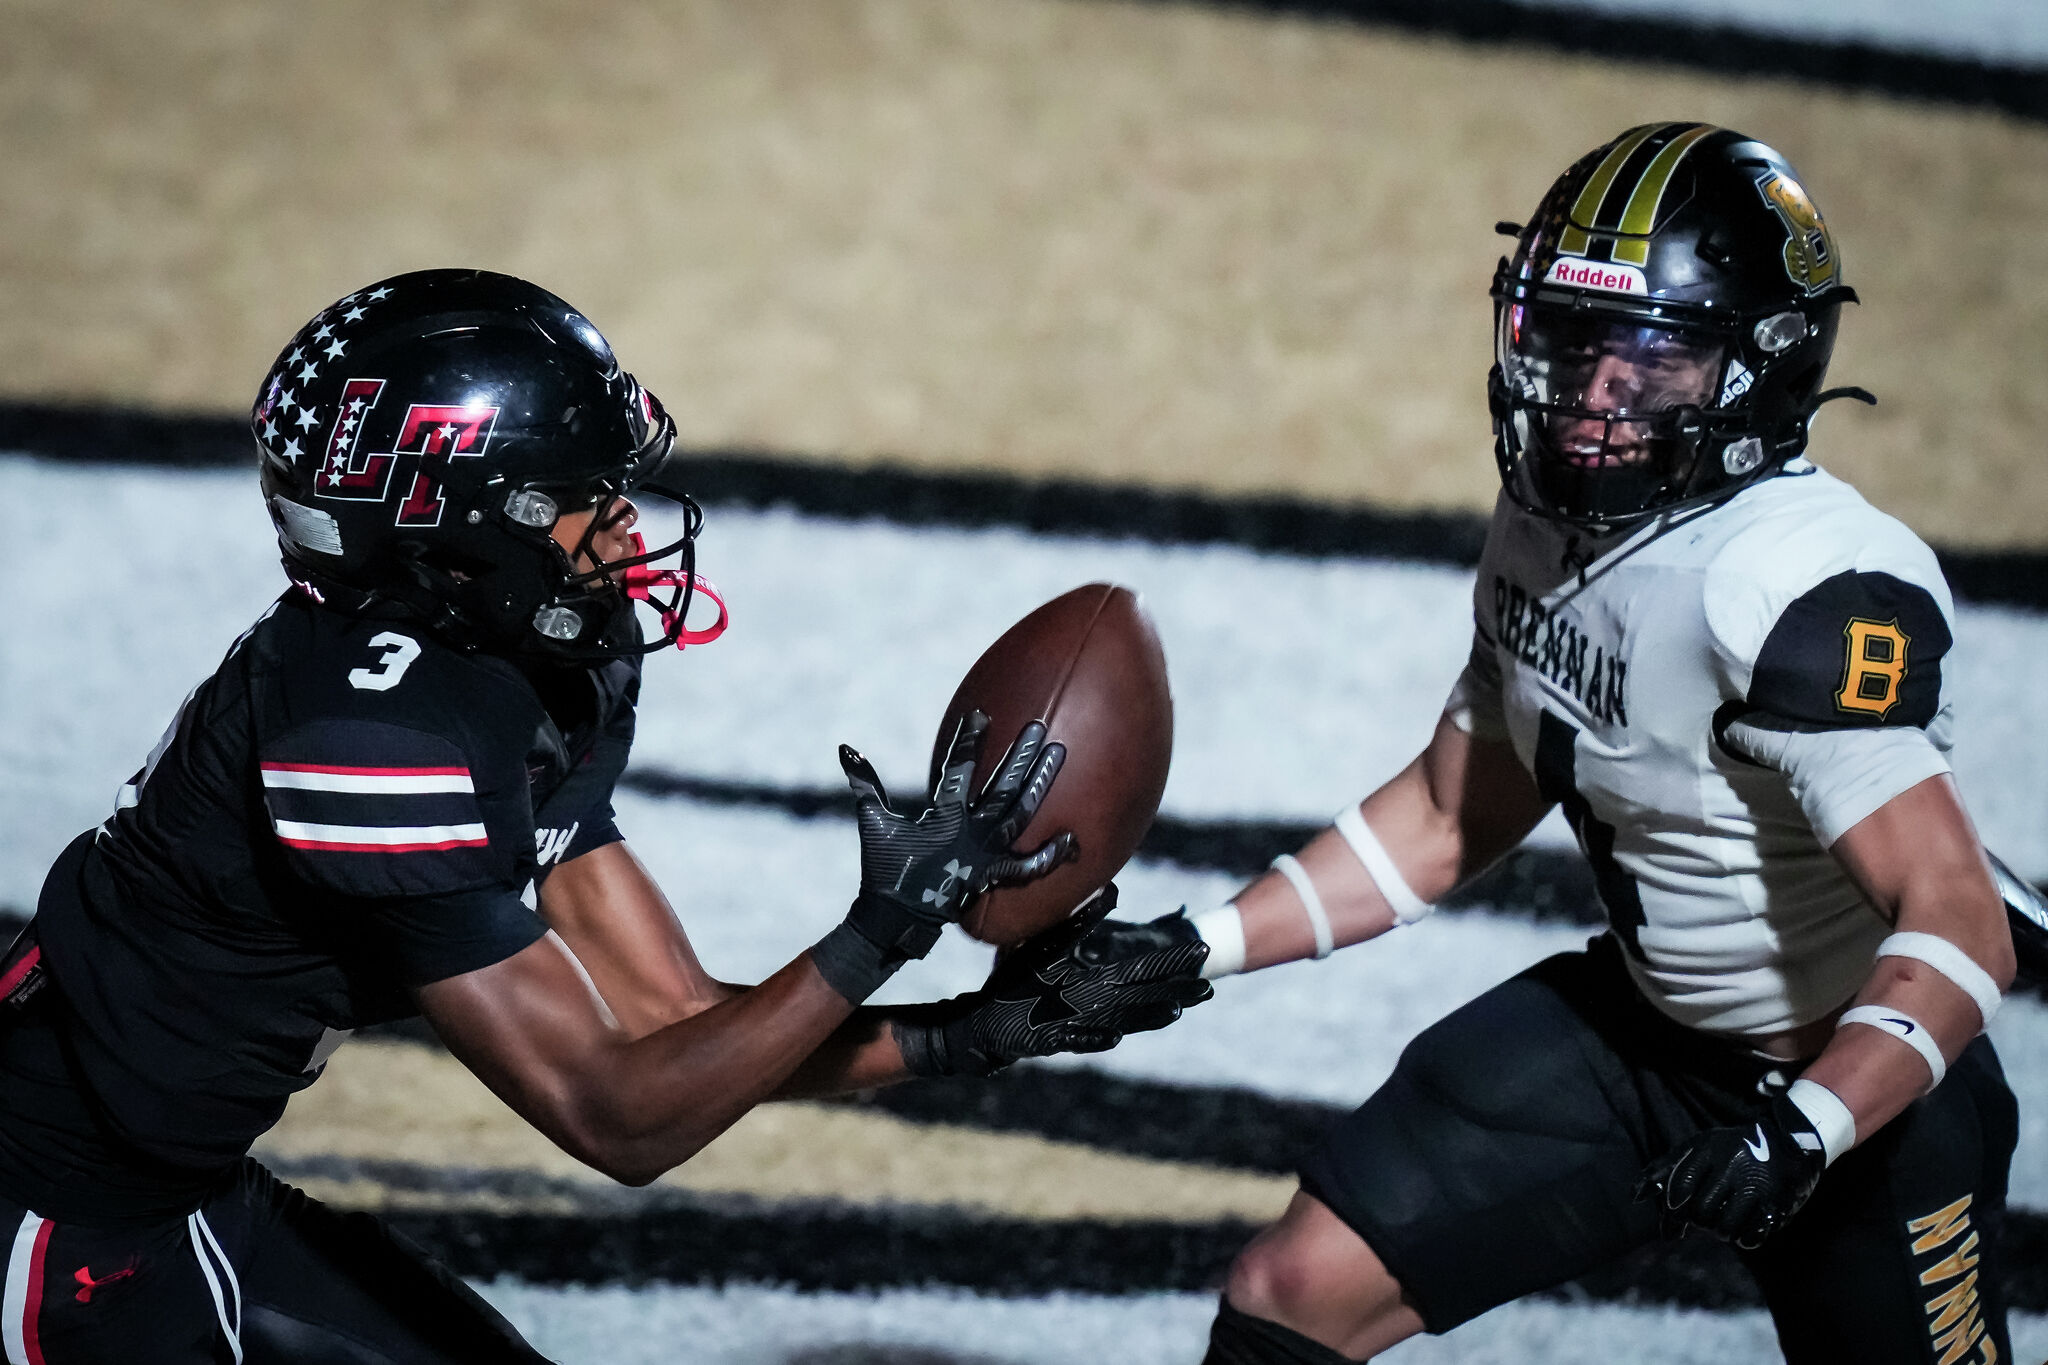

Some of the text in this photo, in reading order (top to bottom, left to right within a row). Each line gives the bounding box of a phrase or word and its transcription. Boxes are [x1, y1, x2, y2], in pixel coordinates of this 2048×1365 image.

[1556, 264, 1632, 290] Riddell
[314, 378, 500, 527] LT
[347, 630, 422, 692] 3
[1834, 616, 1911, 722] B
